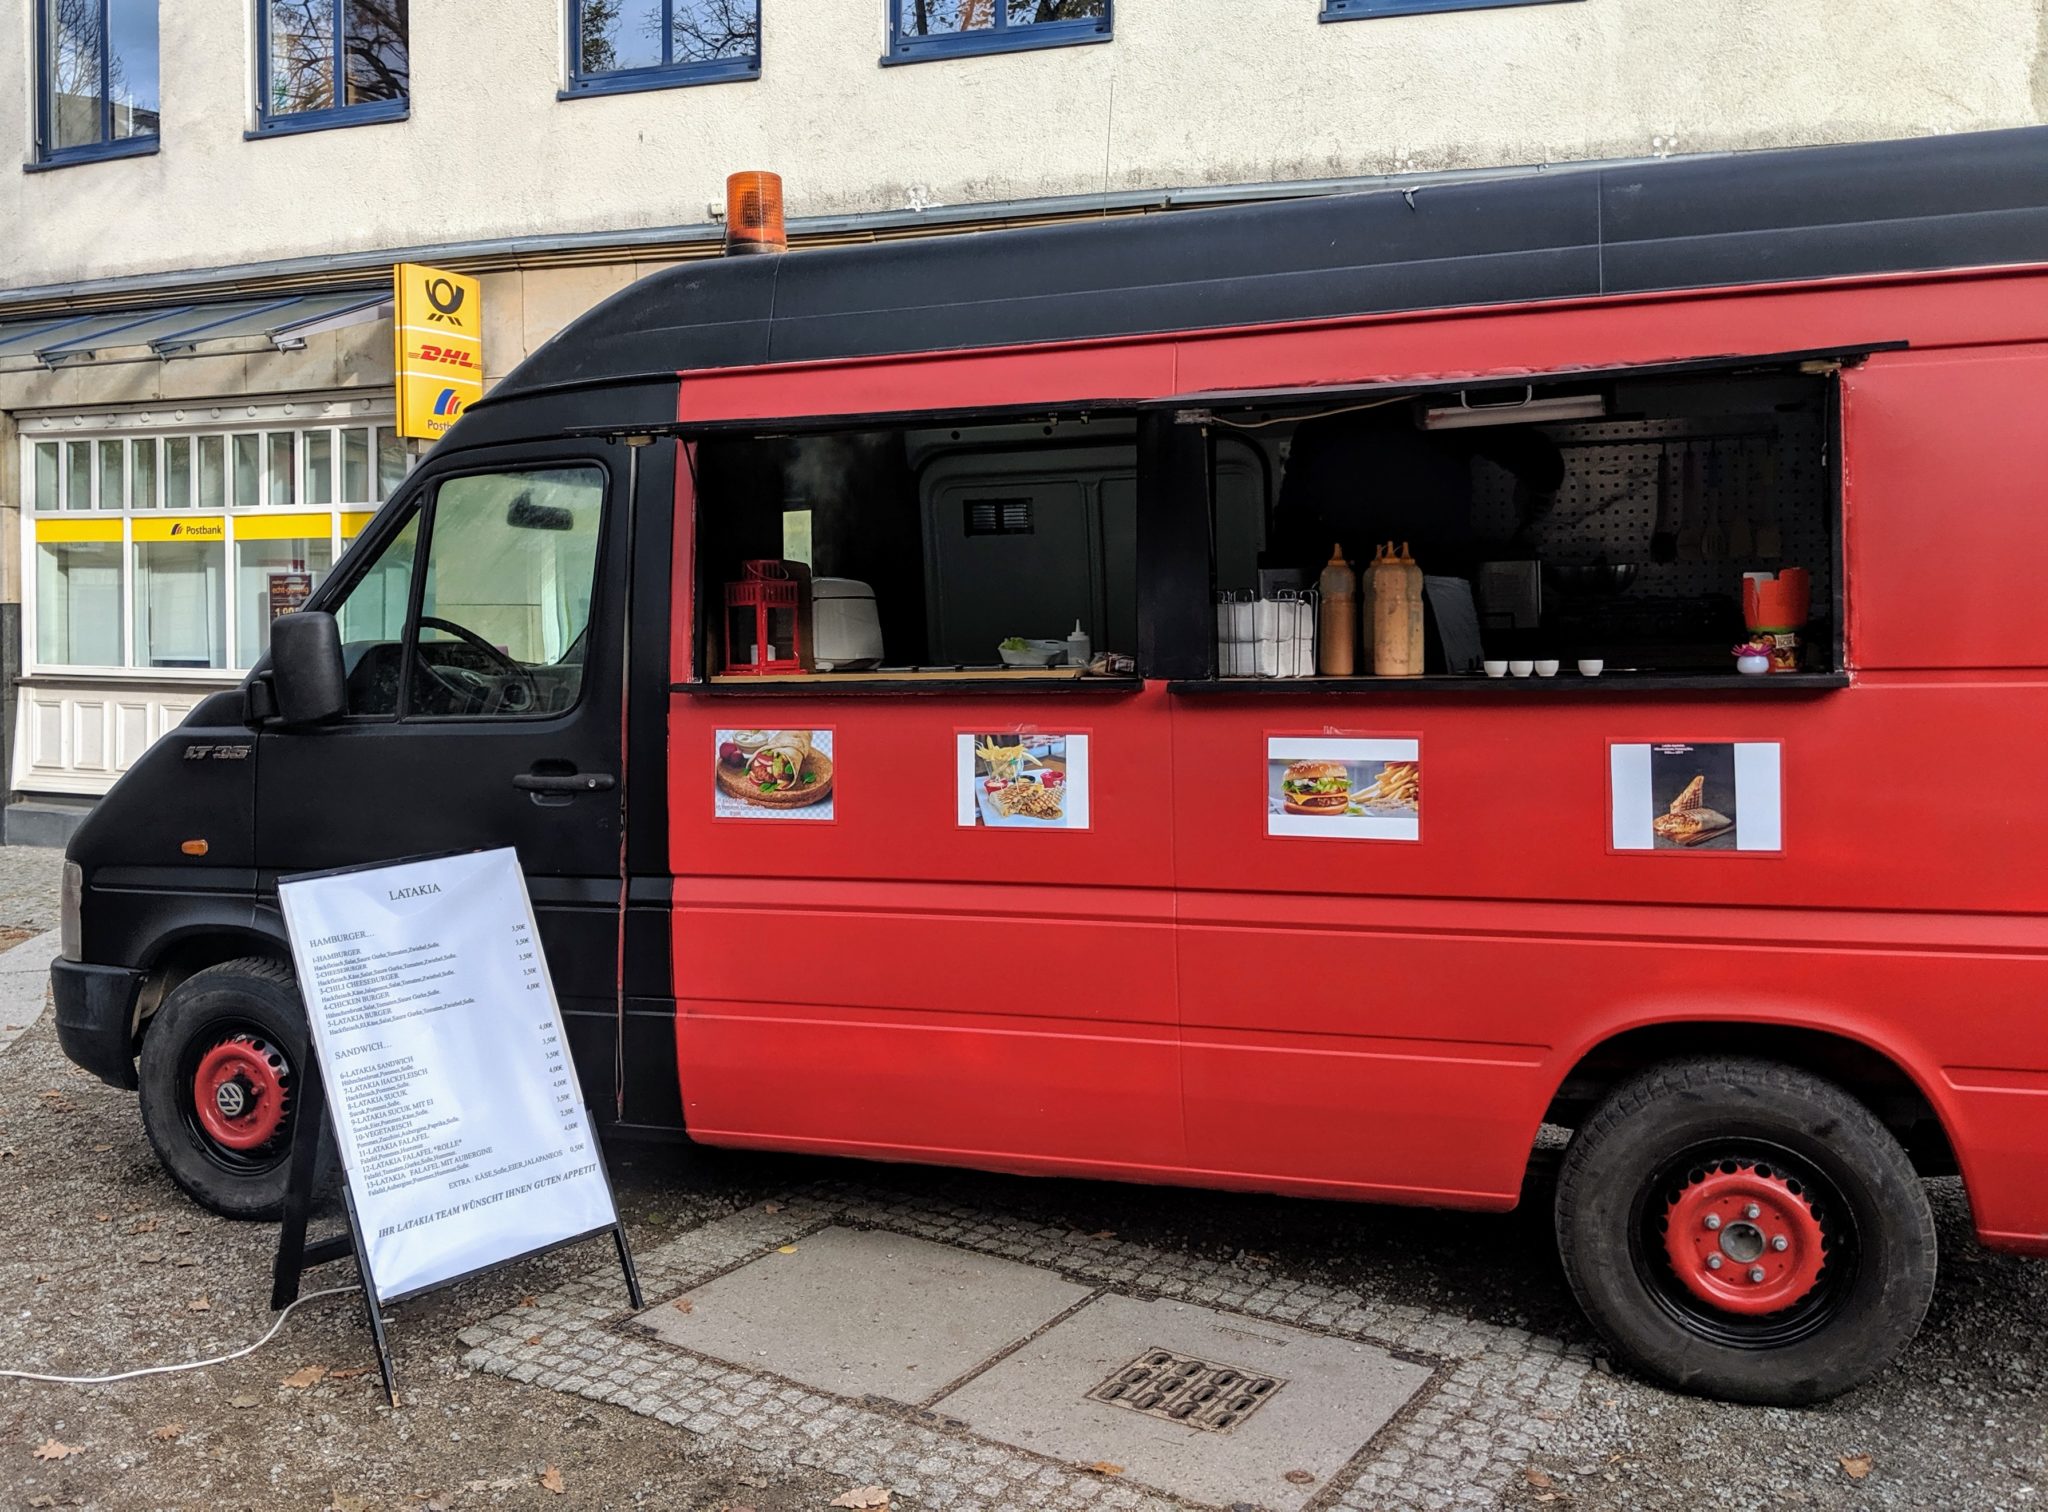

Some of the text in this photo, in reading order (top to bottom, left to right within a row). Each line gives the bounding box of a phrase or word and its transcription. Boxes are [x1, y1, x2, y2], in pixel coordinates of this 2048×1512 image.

[420, 344, 473, 368] DHL
[427, 419, 453, 433] Postb
[186, 525, 222, 535] Postbank
[184, 745, 252, 760] LT 35
[389, 884, 441, 900] LATAKIA
[313, 949, 361, 963] 1-HAMBURGER
[320, 973, 399, 995] 3-CHILI CHEESEBURGER
[324, 992, 390, 1010] 4-CHICKEN BURGER
[328, 1008, 392, 1027] 5-LATAKIA BURGER
[340, 1056, 413, 1079] 6-LATAKIA SANDWICH
[344, 1068, 428, 1094] 7-LATAKIA HACKFLEISCH
[384, 1089, 408, 1101] SUCUK
[351, 1098, 434, 1125] 9-LATAKIA SUCUK MIT EI
[356, 1121, 412, 1141] 10-VEGETARISCH
[359, 1133, 429, 1157] 11-LATAKIA FALAFEL
[363, 1157, 402, 1173] 12-LATAKIA
[402, 1148, 433, 1161] FALAFEL
[367, 1147, 492, 1189] 13-LATAKIA FALAFEL MIT AUBERGINE
[448, 1178, 471, 1189] EXTRA
[379, 1163, 596, 1238] IHR LATAKIA TEAM WÜNSCHT IHNEN GUTEN APPETIT
